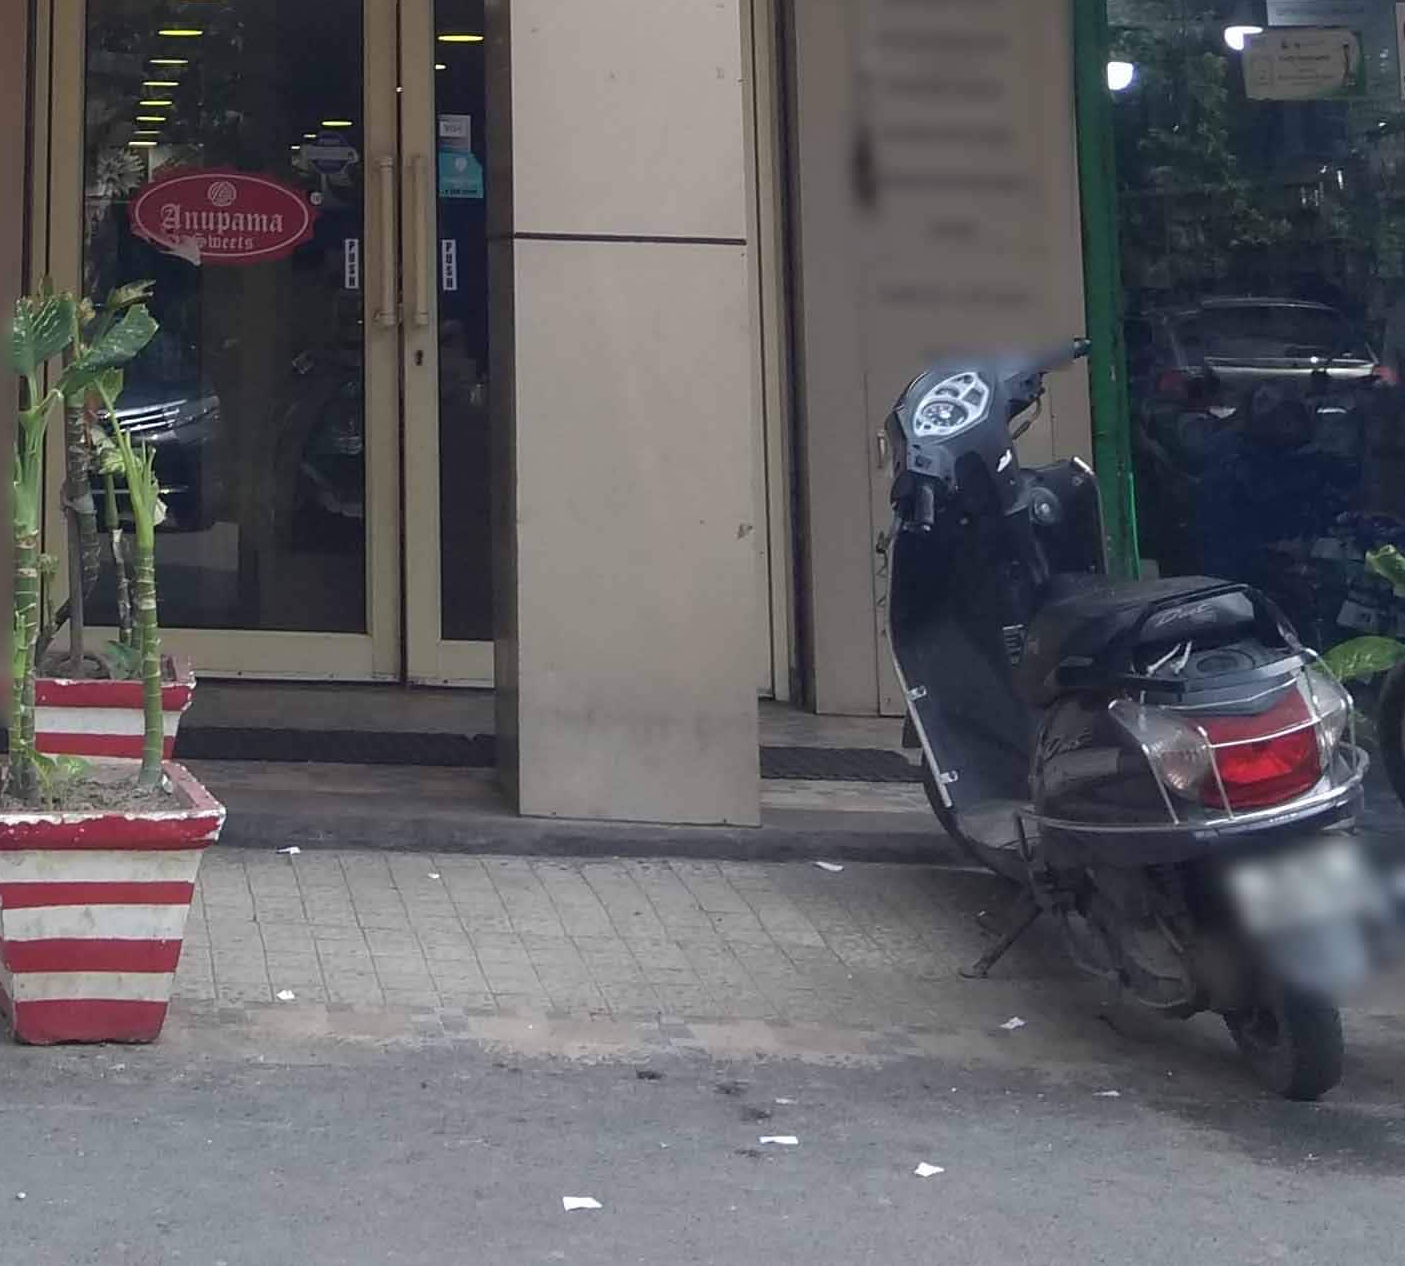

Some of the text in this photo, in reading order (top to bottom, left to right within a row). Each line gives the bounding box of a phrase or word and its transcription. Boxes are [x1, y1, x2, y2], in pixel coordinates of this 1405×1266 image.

[160, 203, 284, 234] Anupama
[347, 239, 357, 288] PUSH
[443, 240, 455, 289] PUSH
